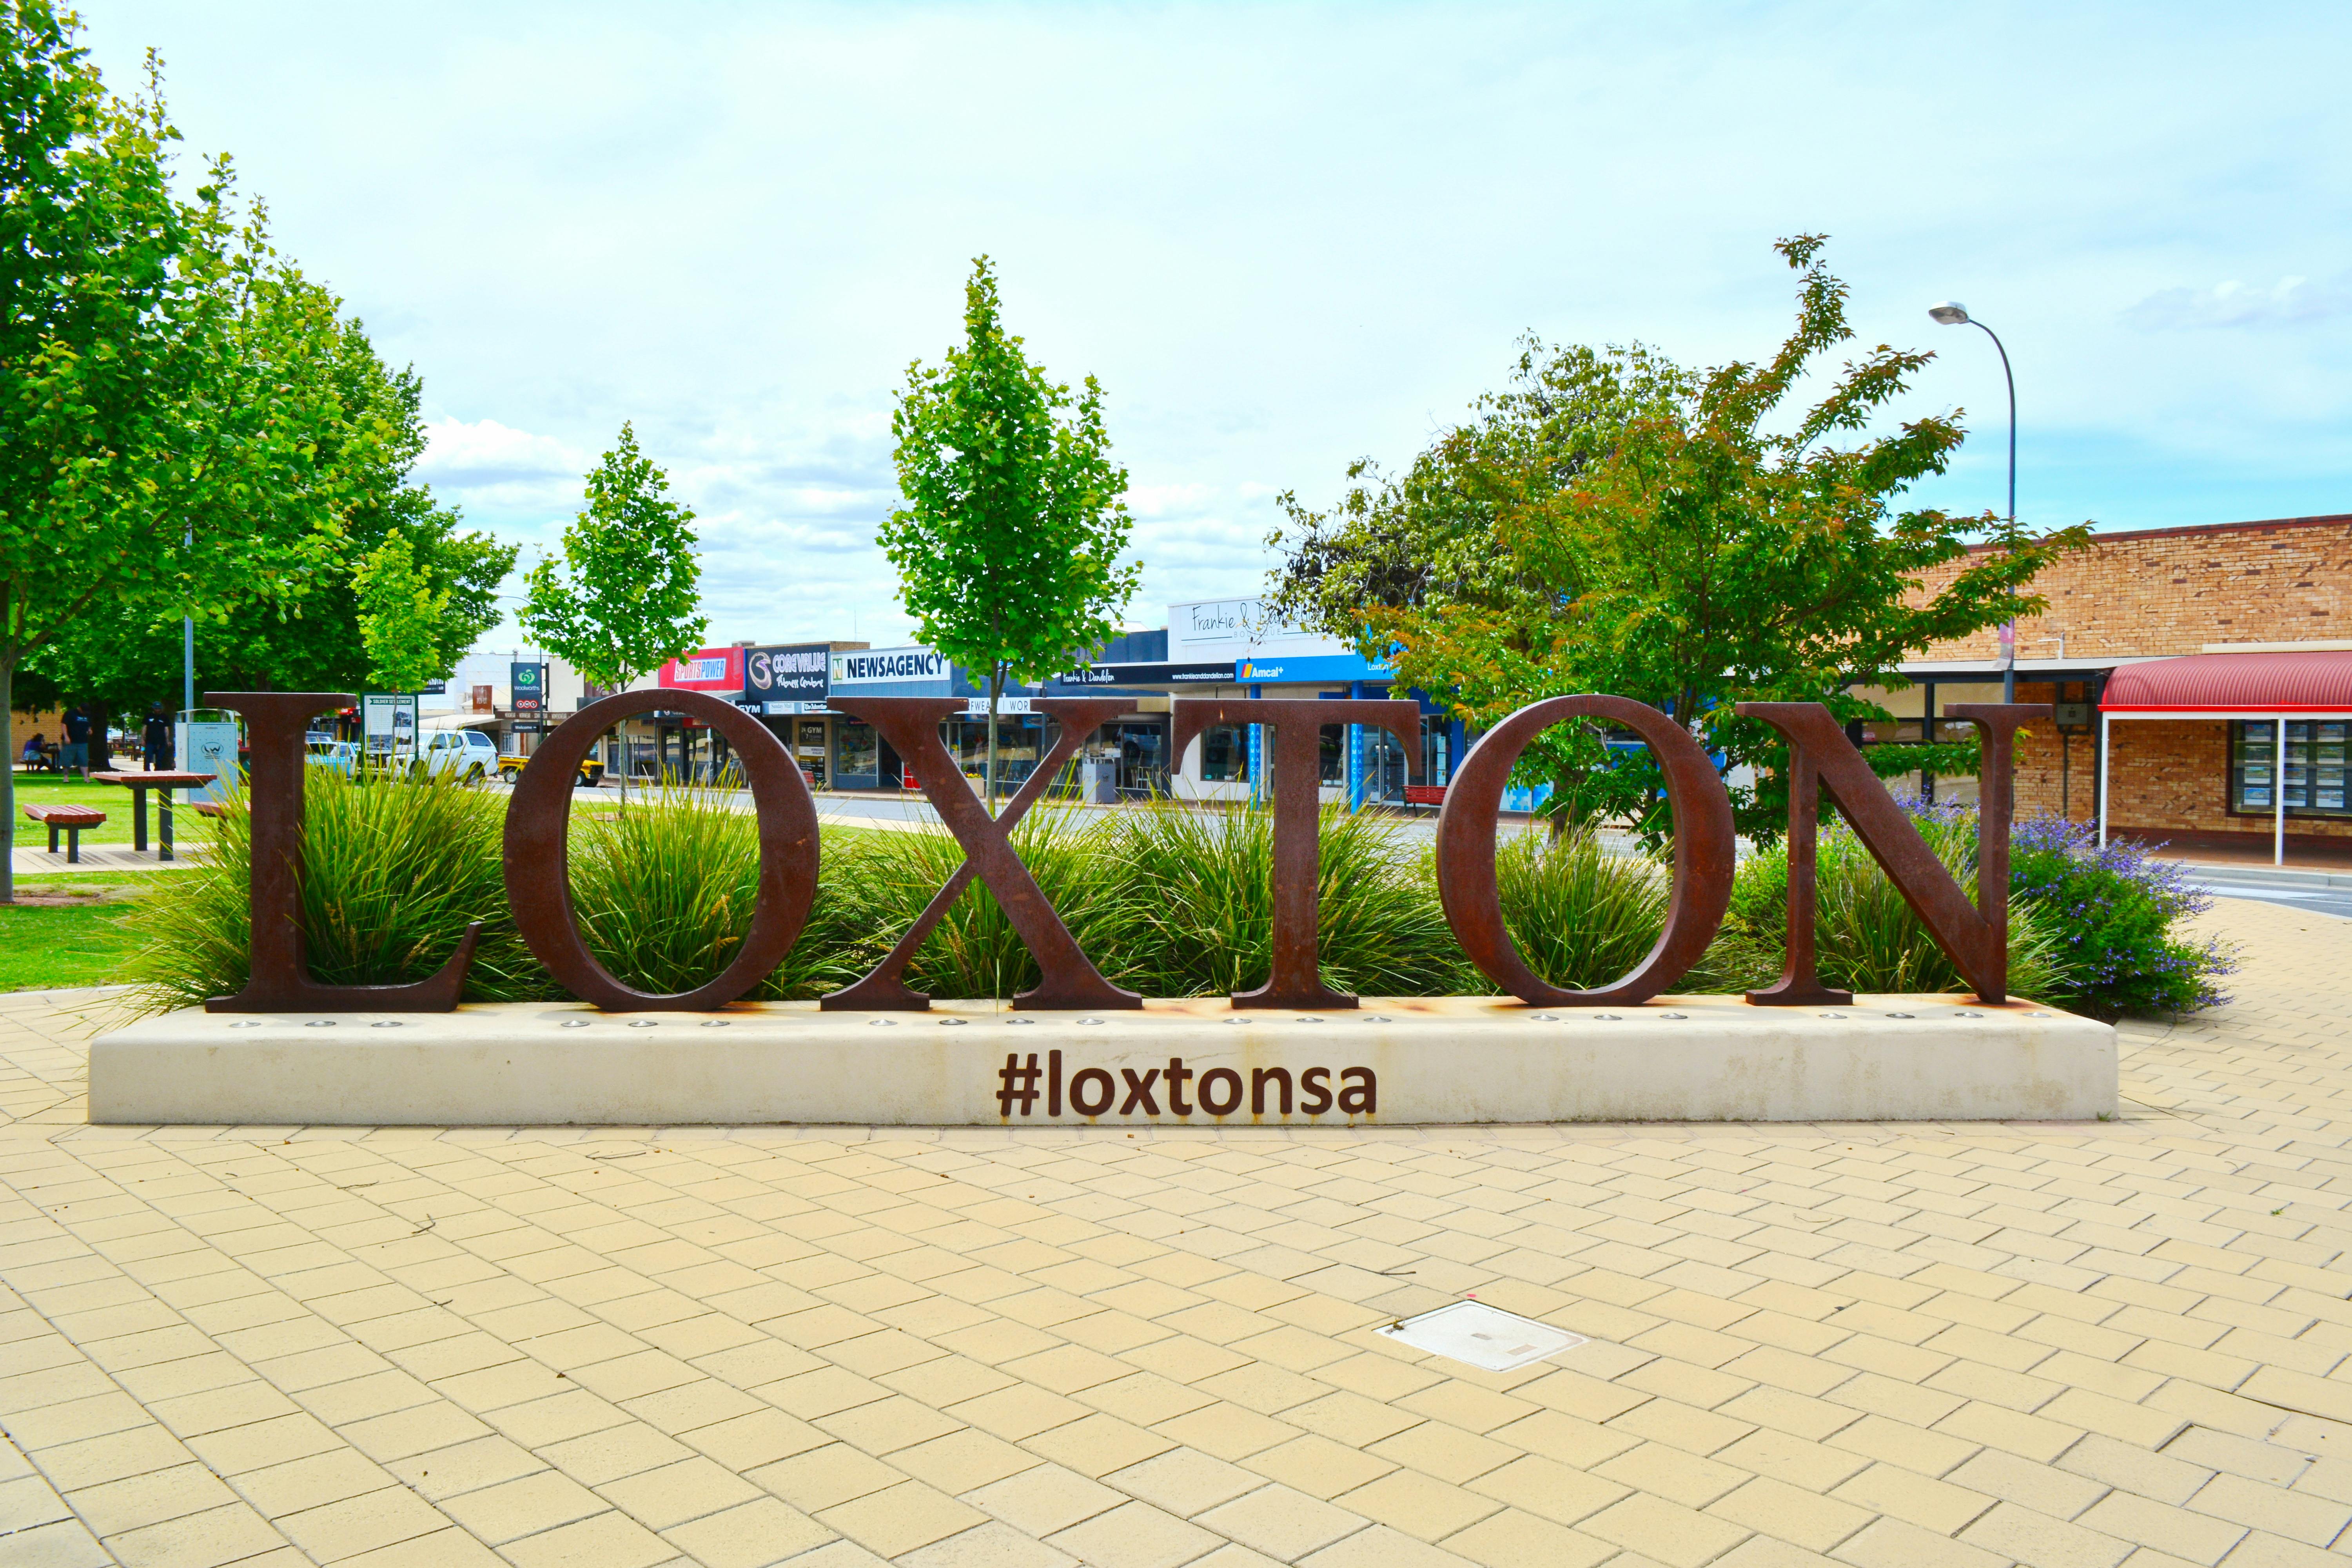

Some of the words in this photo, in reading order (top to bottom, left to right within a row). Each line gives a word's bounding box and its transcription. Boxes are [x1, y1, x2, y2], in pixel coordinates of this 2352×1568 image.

[1192, 604, 1235, 631] Frankie
[1240, 603, 1251, 629] &
[1234, 628, 1281, 638] BOUTIQUE
[676, 661, 724, 679] SPORTSPOWER
[847, 653, 944, 678] NEWSAGENCY
[1063, 671, 1080, 682] Frankie
[1082, 670, 1086, 683] &
[1089, 668, 1114, 684] Dandelion
[1010, 701, 1028, 711] WOR
[203, 688, 2053, 1013] LOXTON
[996, 1049, 1377, 1116] #loxtonsa
